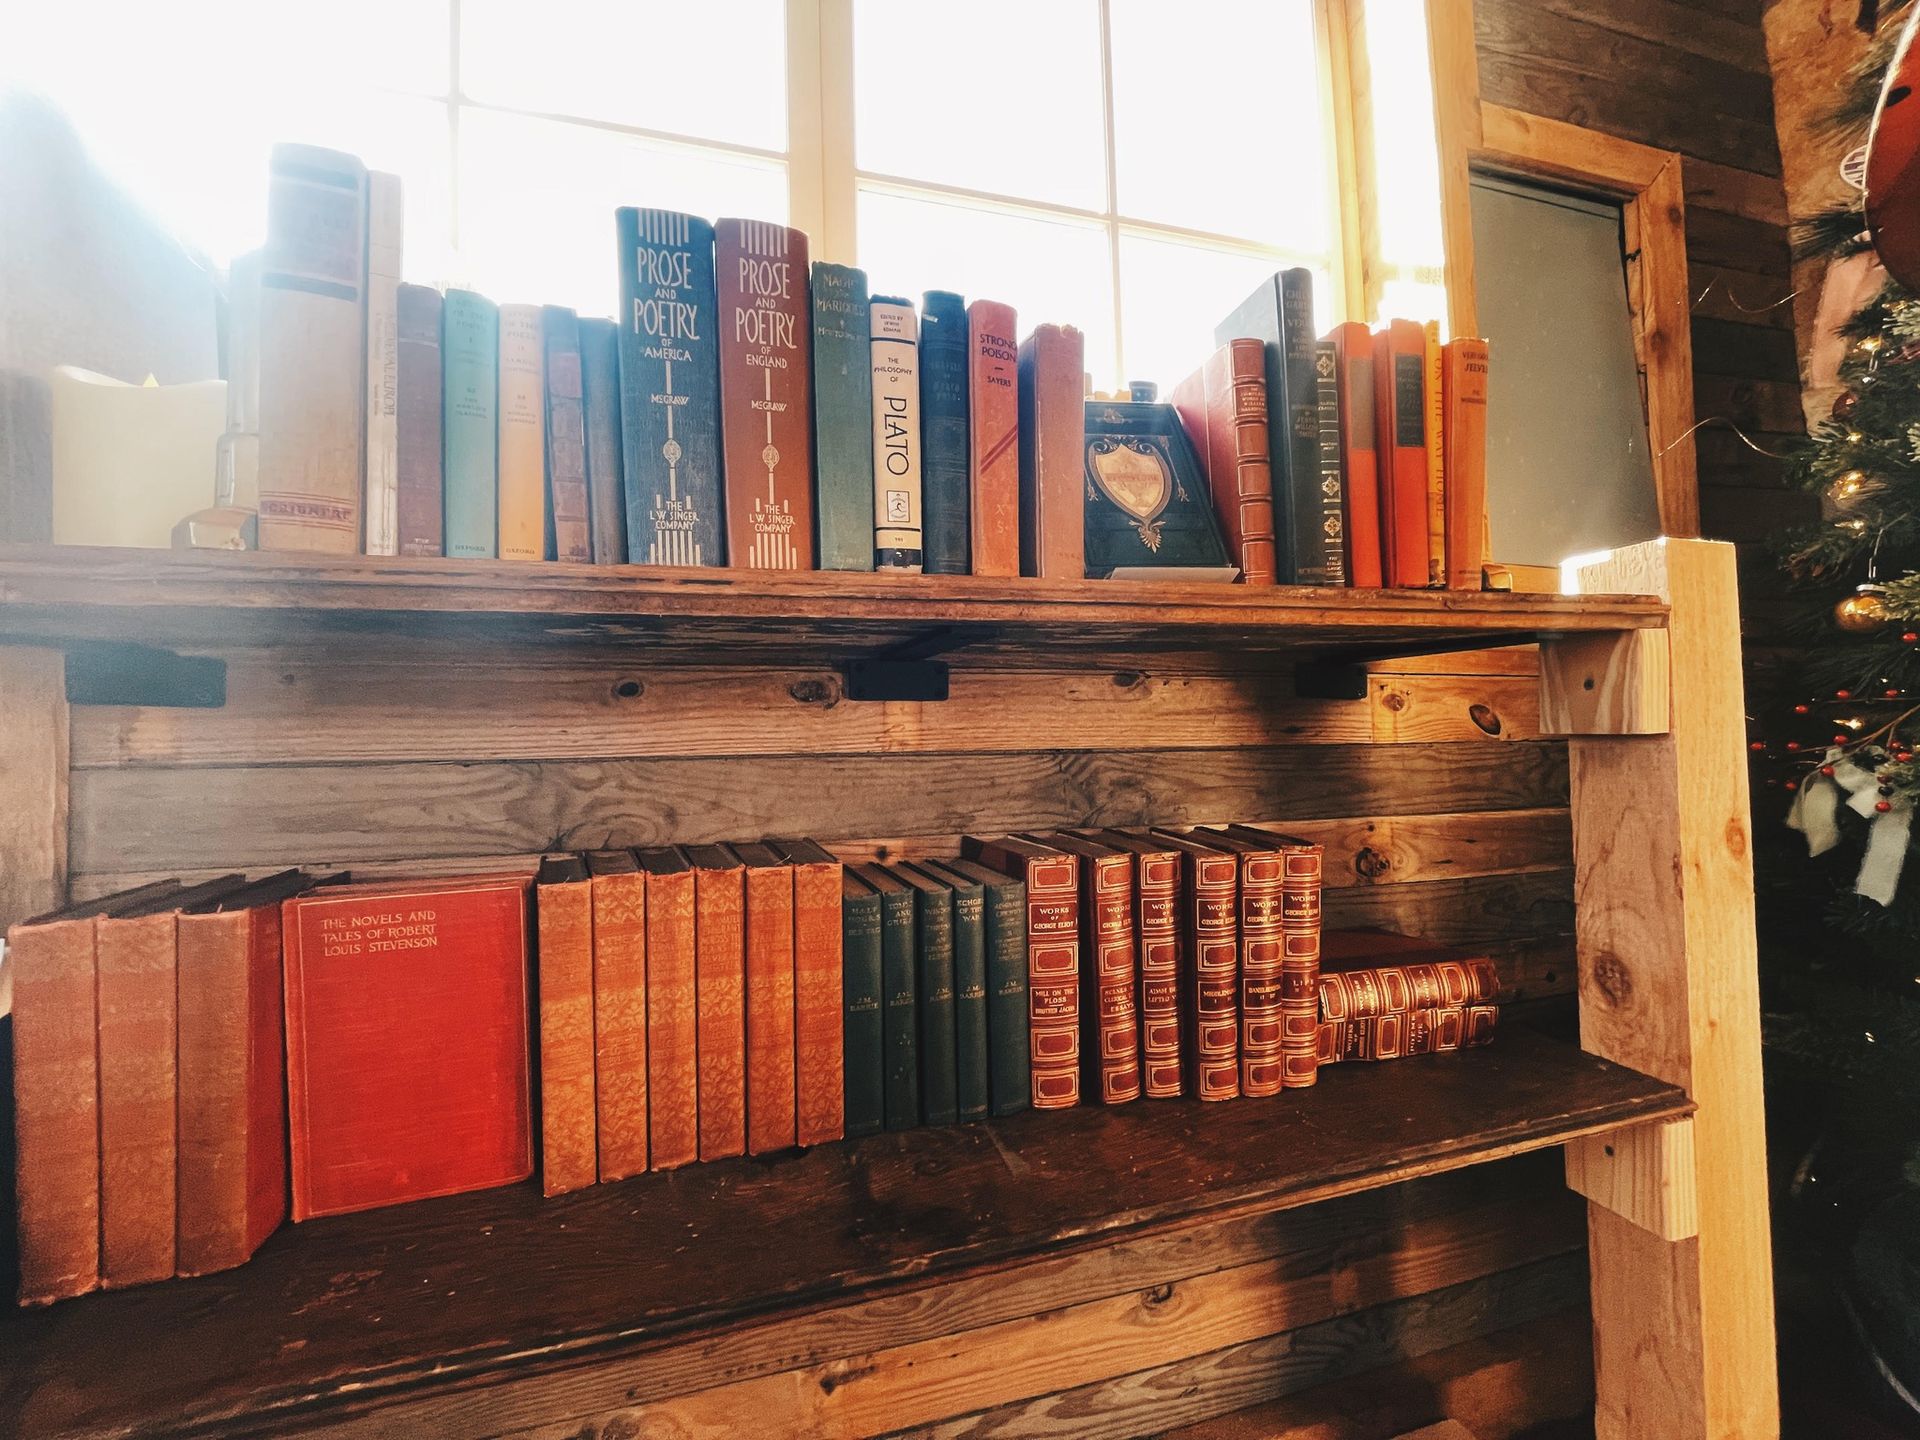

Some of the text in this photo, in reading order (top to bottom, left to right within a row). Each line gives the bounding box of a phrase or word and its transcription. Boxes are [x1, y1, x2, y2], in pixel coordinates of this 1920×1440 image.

[637, 246, 692, 289] PROSE
[739, 257, 790, 299] PROSE
[655, 288, 676, 299] AND
[755, 297, 776, 309] AND
[633, 298, 700, 340] POETRY
[735, 306, 797, 349] POETRY
[661, 338, 672, 346] OF
[980, 333, 1017, 351] STRONG
[644, 346, 692, 362] AMERICA
[761, 346, 771, 354] OF
[982, 346, 1016, 362] POISON
[746, 353, 788, 369] ENGLAND
[874, 366, 912, 375] PHILOSOPHY
[987, 375, 1011, 387] SAYERS
[883, 396, 909, 475] PLATO
[666, 501, 683, 511] THE
[764, 504, 780, 515] THE
[650, 510, 700, 521] L W SINGER
[749, 513, 796, 525] L W SINGER
[655, 520, 695, 531] COMPANY
[754, 523, 792, 533] COMPANY
[1040, 907, 1069, 915] WORKS
[322, 911, 436, 929] THE NOVELS AND
[322, 924, 437, 944] TALES OF ROBERT
[324, 936, 438, 957] LOUIS STEVENSON
